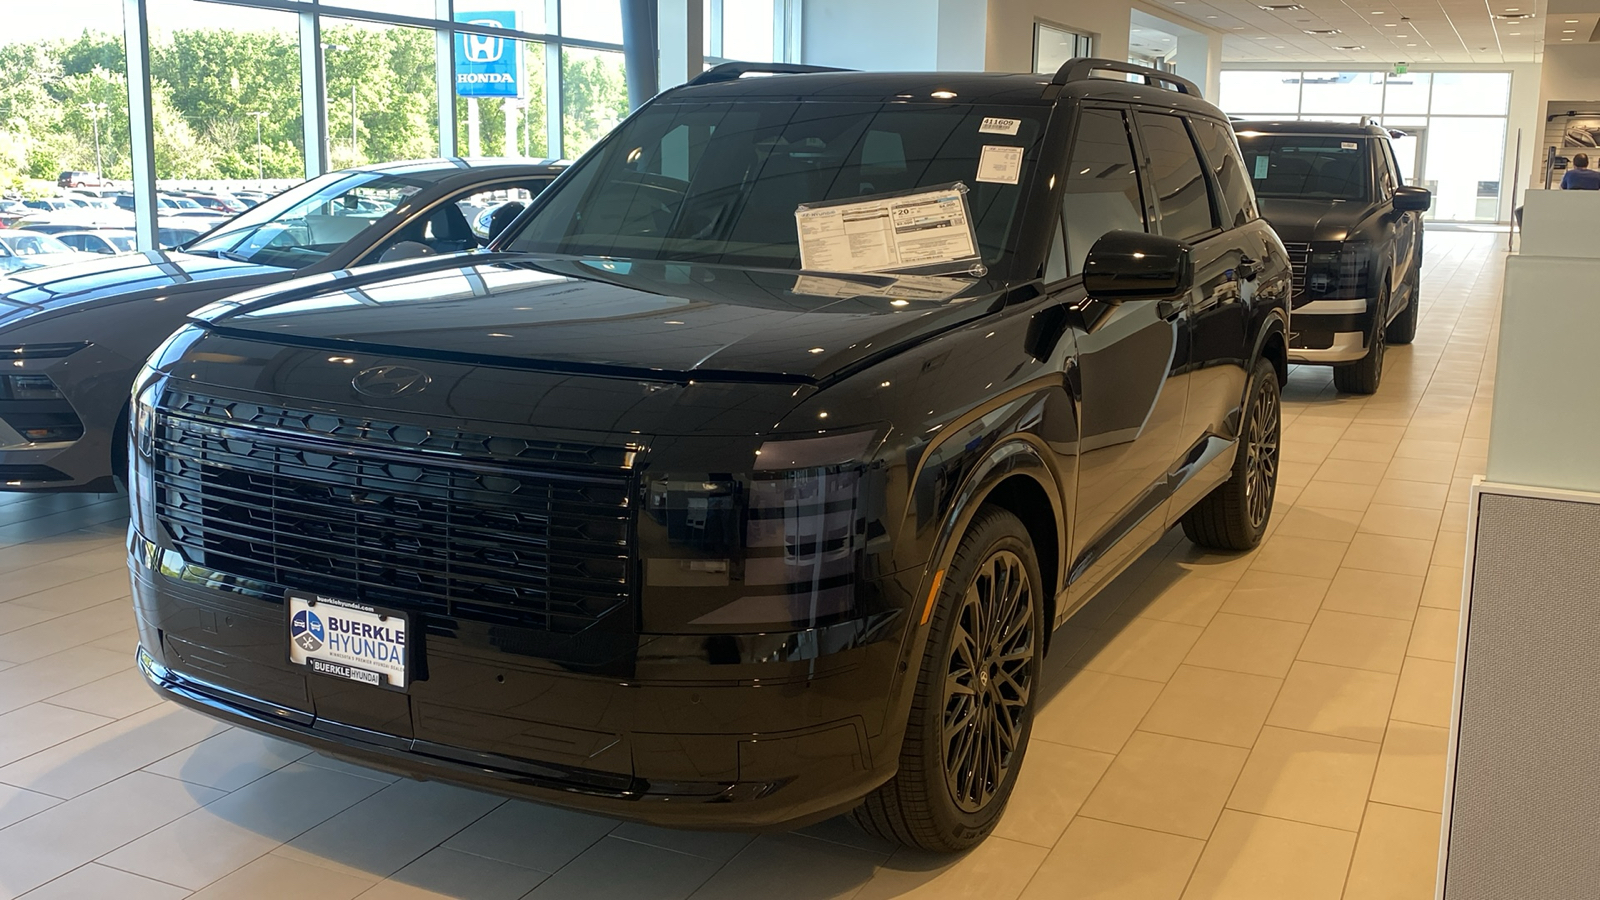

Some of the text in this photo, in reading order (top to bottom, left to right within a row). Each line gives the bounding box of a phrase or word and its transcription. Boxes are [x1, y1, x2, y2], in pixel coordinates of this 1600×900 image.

[457, 73, 515, 84] HONDA
[983, 118, 1014, 126] 411609
[898, 208, 909, 216] 20
[316, 595, 375, 612] buerklehyundai.com
[328, 616, 405, 646] BUERKLE
[329, 631, 405, 667] HYUNDAI
[314, 661, 378, 684] BUERKLE HYUNDAI
